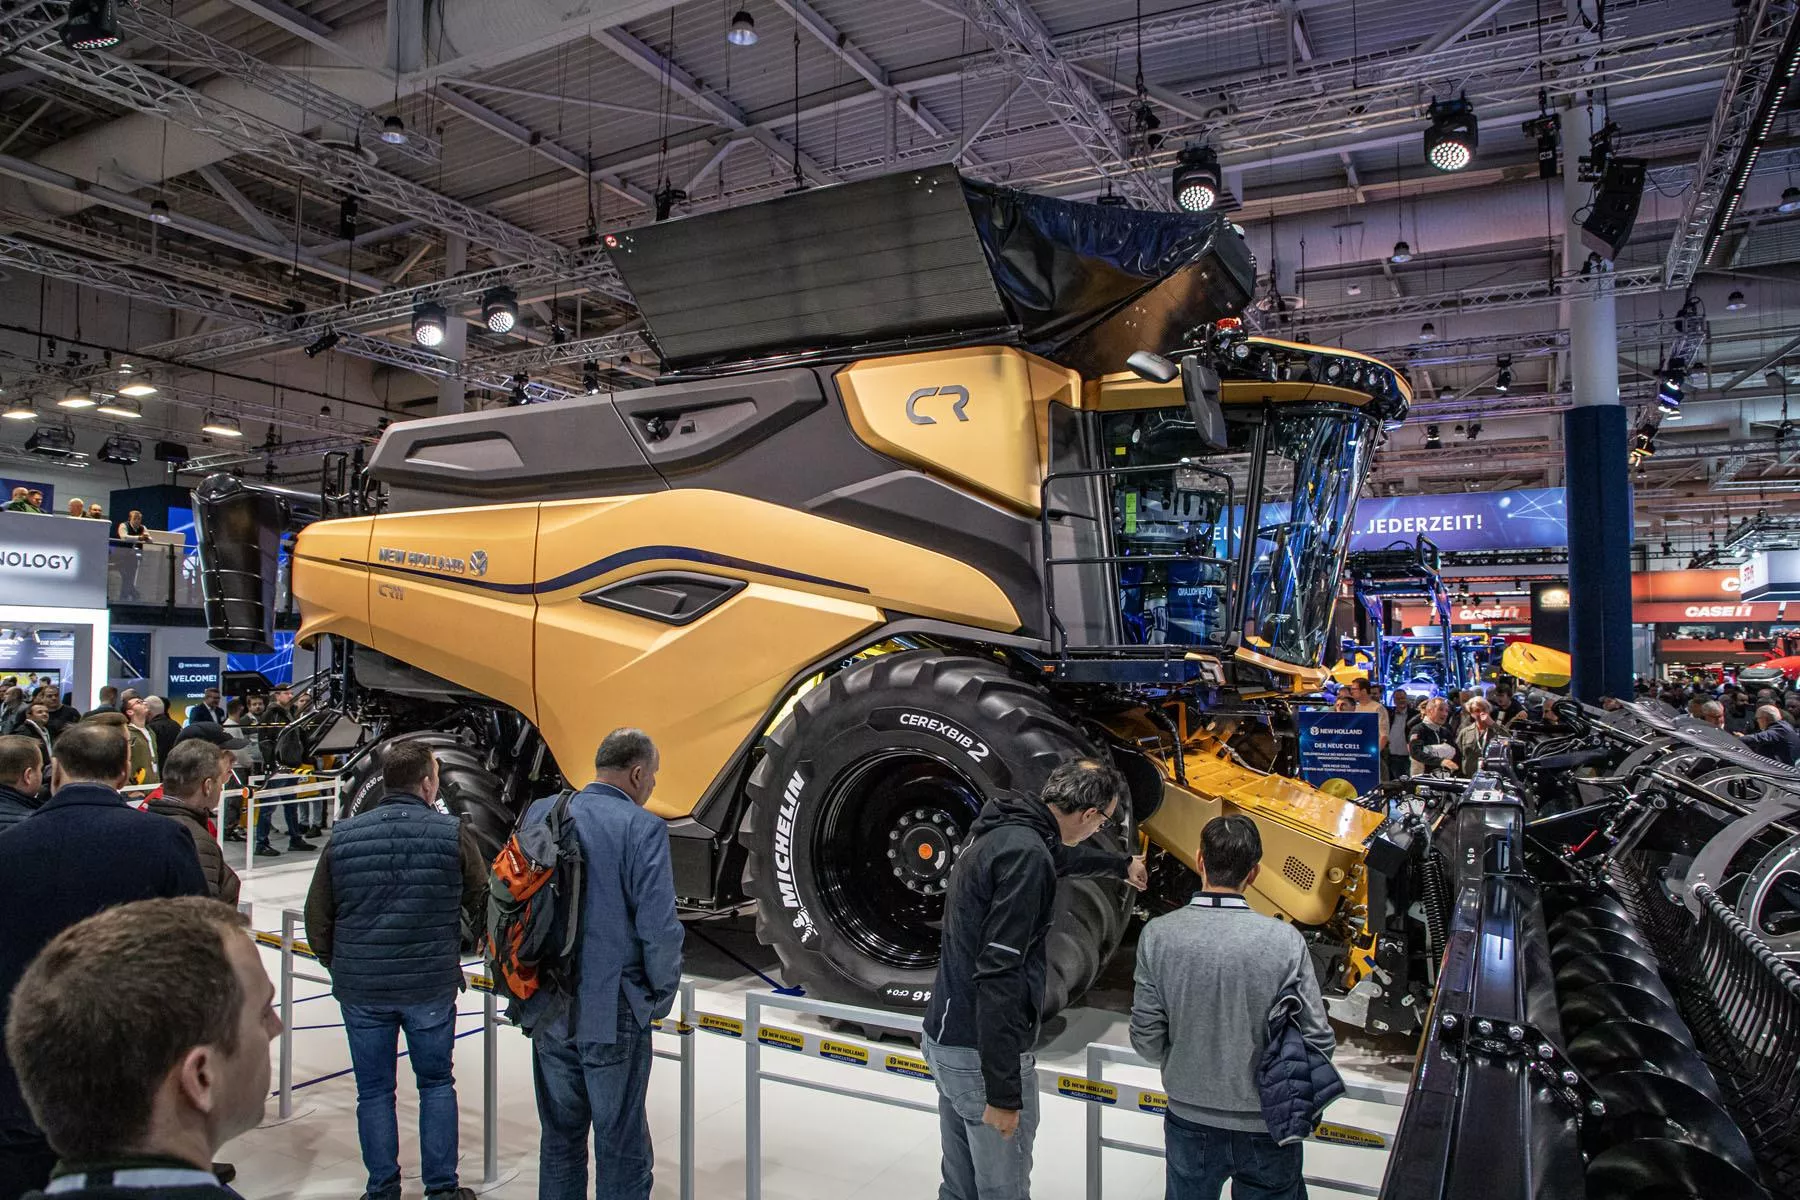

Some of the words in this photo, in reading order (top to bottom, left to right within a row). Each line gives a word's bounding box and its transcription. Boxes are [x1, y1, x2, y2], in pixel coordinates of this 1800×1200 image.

[905, 384, 969, 425] CR
[1366, 514, 1483, 535] JEDERZEIT!
[379, 547, 406, 564] NEW
[408, 551, 466, 574] HOLLAND
[1685, 606, 1736, 618] CASE
[170, 674, 217, 683] WELCOME!
[899, 713, 973, 748] CEREXBIB
[967, 742, 990, 763] 2
[774, 770, 805, 908] MICHELIN
[779, 1034, 801, 1044] HOLLAND
[842, 1047, 865, 1057] HOLLAND
[910, 1062, 930, 1071] HOLLAN
[1086, 1085, 1113, 1095] HOLLAND
